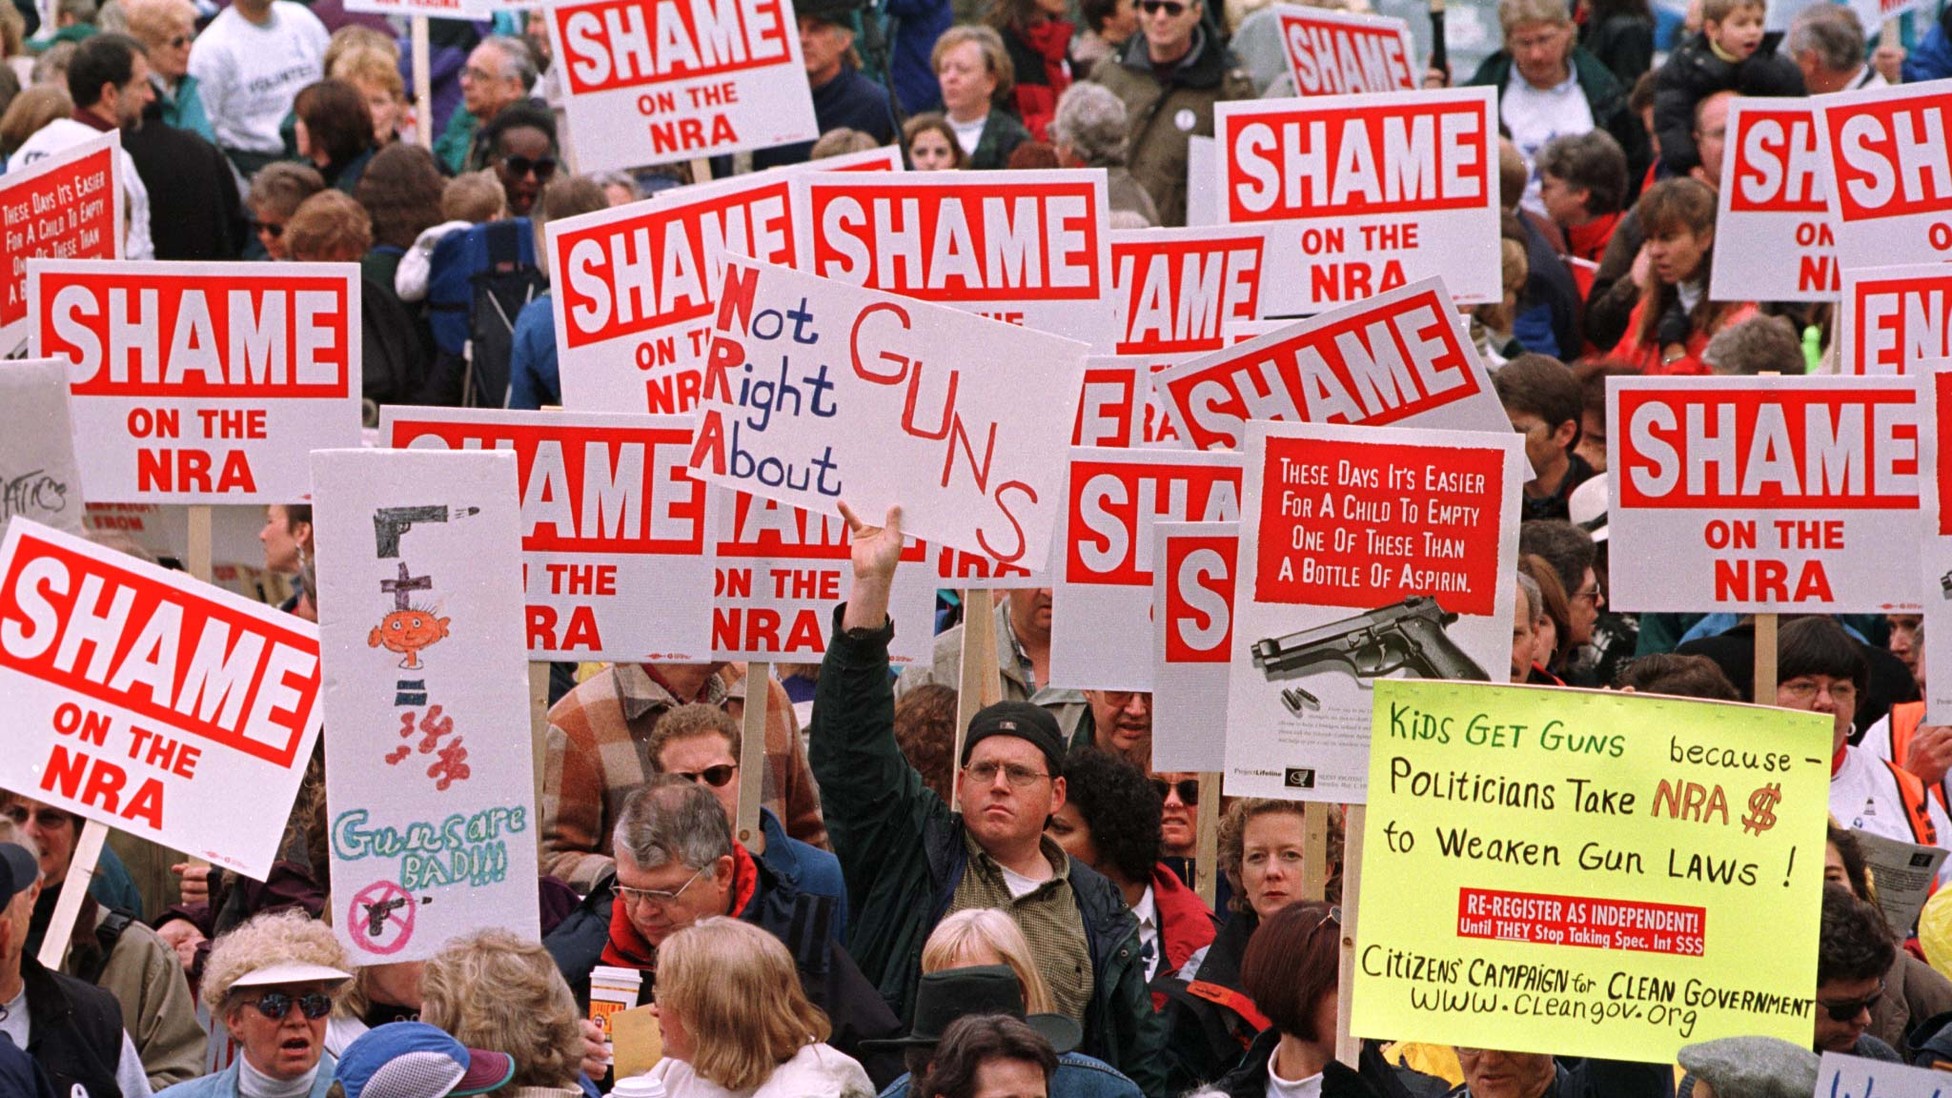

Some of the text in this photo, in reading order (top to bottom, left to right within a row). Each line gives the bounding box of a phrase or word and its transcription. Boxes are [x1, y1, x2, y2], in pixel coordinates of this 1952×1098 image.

[564, 0, 785, 86] SHAME
[1287, 23, 1414, 94] SHAME
[637, 82, 738, 116] ON THE
[650, 114, 738, 154] NRA
[1235, 111, 1480, 213] SHAME
[2, 204, 30, 227] THESE
[32, 192, 56, 215] DAYS
[74, 171, 105, 199] EASIER
[6, 199, 104, 253] FOR A CHILD TO EMPTY
[822, 194, 1091, 291] SHAME
[1302, 223, 1419, 255] ON THE
[13, 256, 26, 277] ON
[80, 228, 99, 250] THAN
[567, 195, 791, 334] SHAME
[716, 263, 820, 345] Not
[1311, 260, 1409, 302] NRA
[51, 284, 339, 386] SHAME
[635, 336, 675, 371] ON
[646, 369, 702, 416] NR
[701, 335, 838, 432] Right
[1188, 303, 1470, 451] SHAME
[127, 407, 268, 439] ON THE
[849, 301, 1039, 564] GUNS
[137, 448, 258, 493] NRA
[689, 408, 842, 497] About
[1629, 400, 1920, 498] SHAME
[1280, 457, 1485, 495] THESE DAYS IT'S EASIER
[1281, 490, 1480, 527] FOR A CHILD TO EMPTY
[1292, 524, 1465, 559] ONE OF THESE THAN
[1704, 520, 1845, 550] ON THE
[546, 564, 617, 596] THE
[770, 570, 841, 600] THE
[1278, 556, 1472, 593] A BOTTLE OF ASPIRIN.
[1714, 560, 1834, 603] NRA
[525, 604, 603, 652] RA
[712, 608, 826, 653] NRA
[0, 555, 319, 753] SHAME
[52, 702, 202, 780] ON THE
[1465, 713, 1529, 748] GET
[1539, 719, 1626, 758] GUNS
[1669, 735, 1792, 772] because
[39, 743, 165, 831] NRA
[1565, 777, 1637, 816] Take
[1649, 778, 1731, 827] NRA
[1740, 782, 1783, 838] $
[401, 840, 508, 892] BAD!!!
[1383, 820, 1416, 854] to
[1435, 825, 1560, 867] Weaken
[1577, 841, 1645, 875] Gun
[1460, 917, 1492, 936] Until
[1495, 920, 1532, 940] THEY
[1535, 923, 1565, 946] Stop
[1568, 926, 1611, 950] Taking
[1615, 930, 1649, 950] Spec.
[1653, 934, 1672, 951] Int
[1467, 893, 1699, 934] RE-REGISTER AS INDEPENDENT!
[1571, 972, 1597, 994] for
[1607, 971, 1676, 1003] CLEAN
[1683, 978, 1818, 1020] GOVERNMENT
